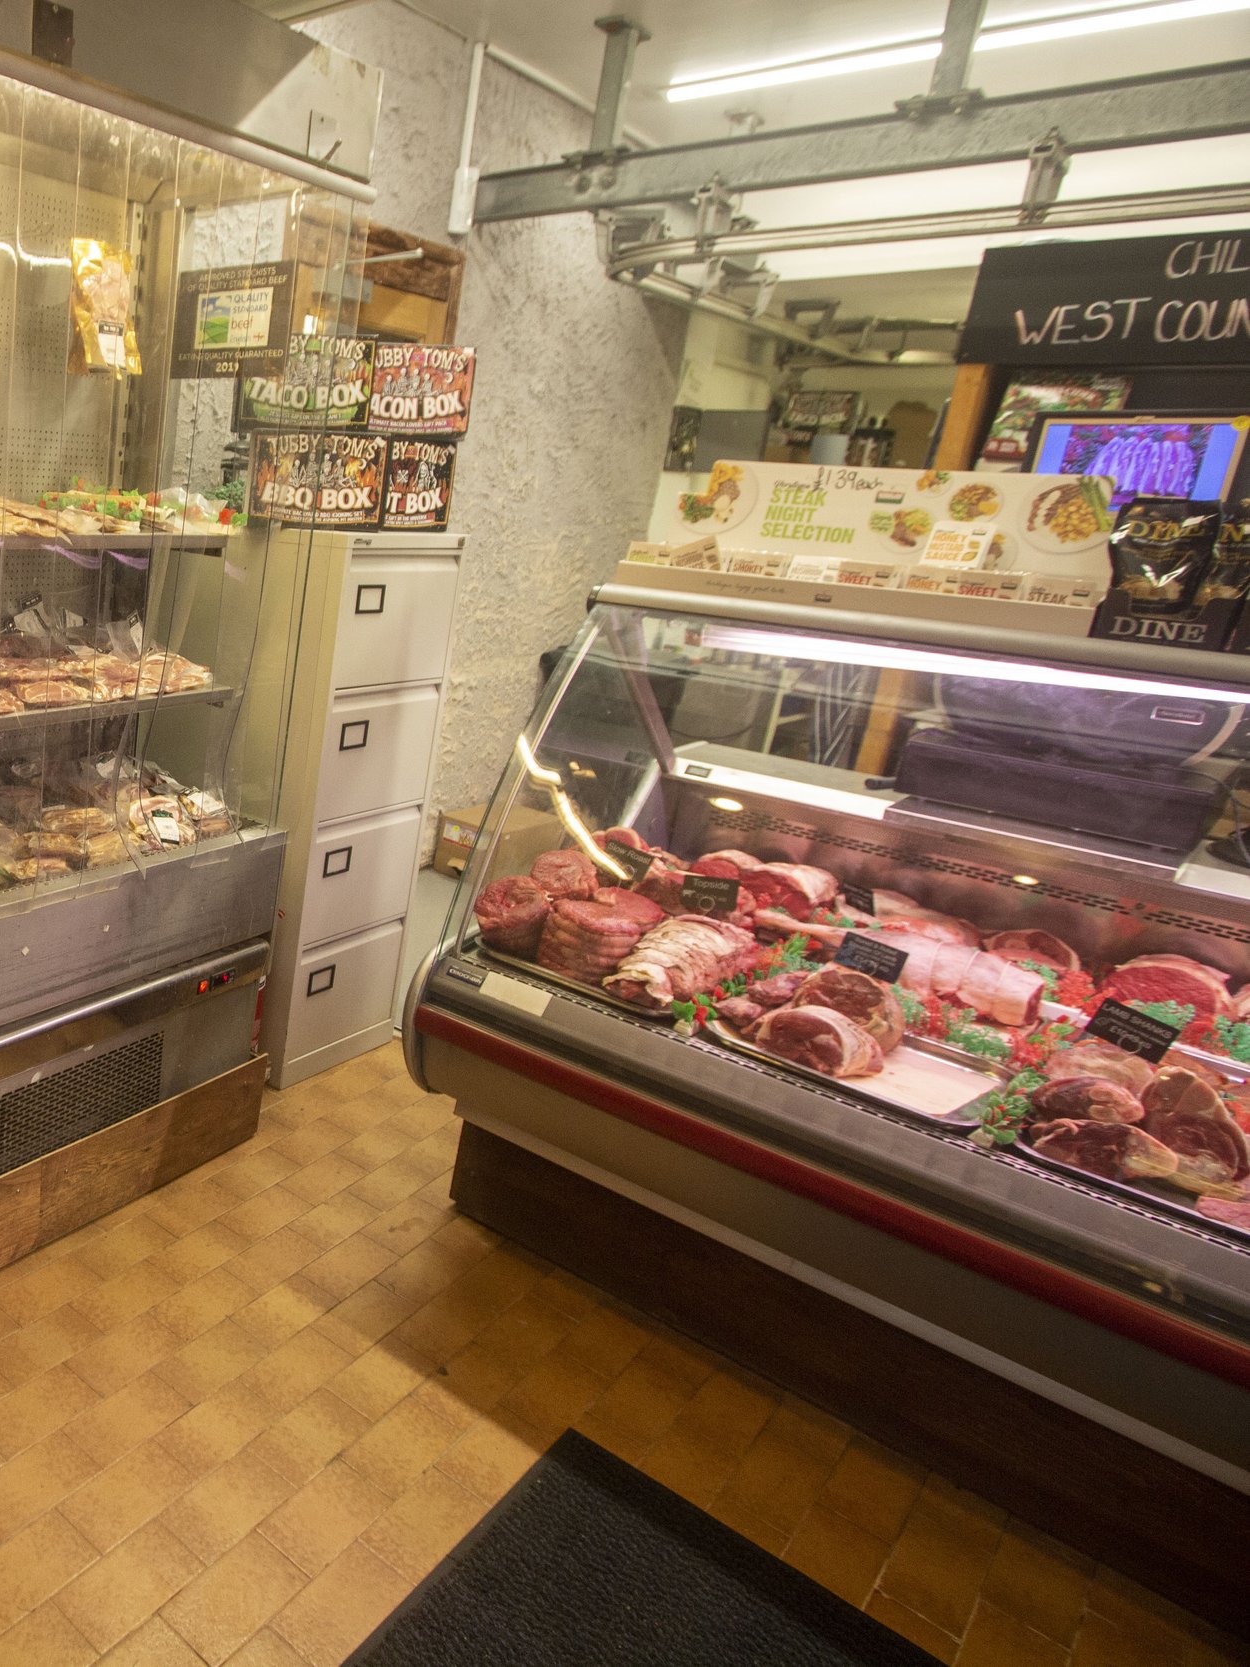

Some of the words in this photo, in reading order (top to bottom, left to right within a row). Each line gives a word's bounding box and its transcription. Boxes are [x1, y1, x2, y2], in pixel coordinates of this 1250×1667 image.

[230, 277, 268, 289] STANARD
[269, 274, 288, 284] BEEF
[234, 292, 269, 303] QUALITY
[1015, 296, 1152, 345] WEST
[235, 348, 284, 359] GUARANTEED
[375, 347, 414, 368] UBBY
[422, 348, 467, 373] TOM'S
[250, 377, 308, 410] TACO
[316, 379, 368, 410] BOX
[370, 392, 419, 420] ACON
[423, 390, 465, 419] BOX
[267, 433, 321, 456] TUBBY
[331, 434, 378, 460] TOM'S
[414, 441, 449, 466] TOM'S
[260, 481, 313, 510] BBQ
[321, 486, 373, 510] BOX
[405, 487, 445, 514] BOX
[770, 488, 828, 506] STEAK
[765, 505, 818, 523] NIGHT
[760, 521, 856, 544] SELECTION
[838, 572, 872, 586] SWEET
[958, 584, 999, 597] SWEET
[1027, 591, 1069, 605] STEAK
[1109, 616, 1208, 643] DINE
[608, 842, 626, 855] Slow
[693, 878, 730, 891] Topside
